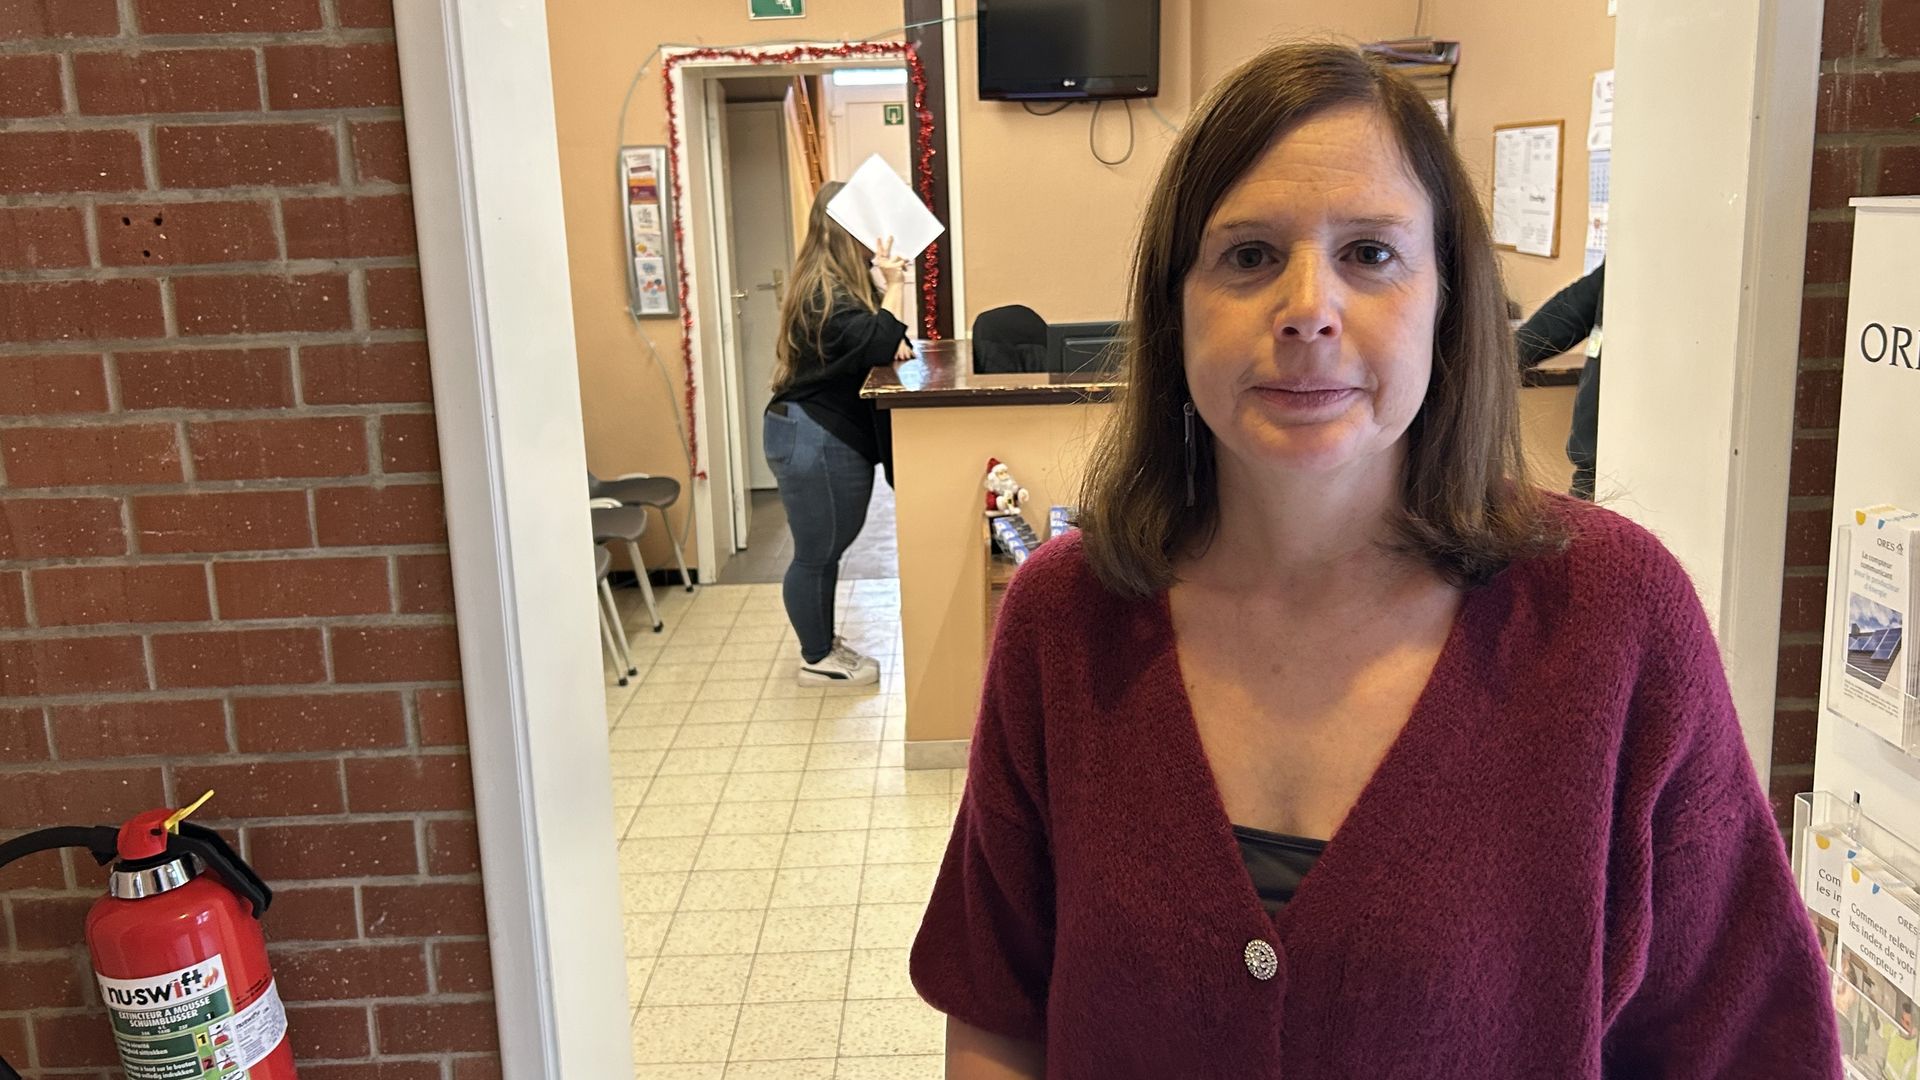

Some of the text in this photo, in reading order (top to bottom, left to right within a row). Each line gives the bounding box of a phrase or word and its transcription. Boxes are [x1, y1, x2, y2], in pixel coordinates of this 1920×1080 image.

[1861, 323, 1920, 369] OR
[1876, 538, 1895, 552] ORES
[1816, 881, 1831, 897] les
[1851, 902, 1888, 938] Comment
[1897, 915, 1918, 936] ORES
[1849, 916, 1860, 933] les
[1861, 926, 1883, 951] index
[1885, 945, 1895, 961] de
[1860, 943, 1904, 983] compteur ?
[118, 1010, 162, 1020] EXTINCTEUR
[173, 997, 211, 1015] MOUSSE
[129, 1009, 199, 1028] SCHUIMBLUSSER
[197, 1034, 207, 1045] 1
[203, 1058, 213, 1070] 2
